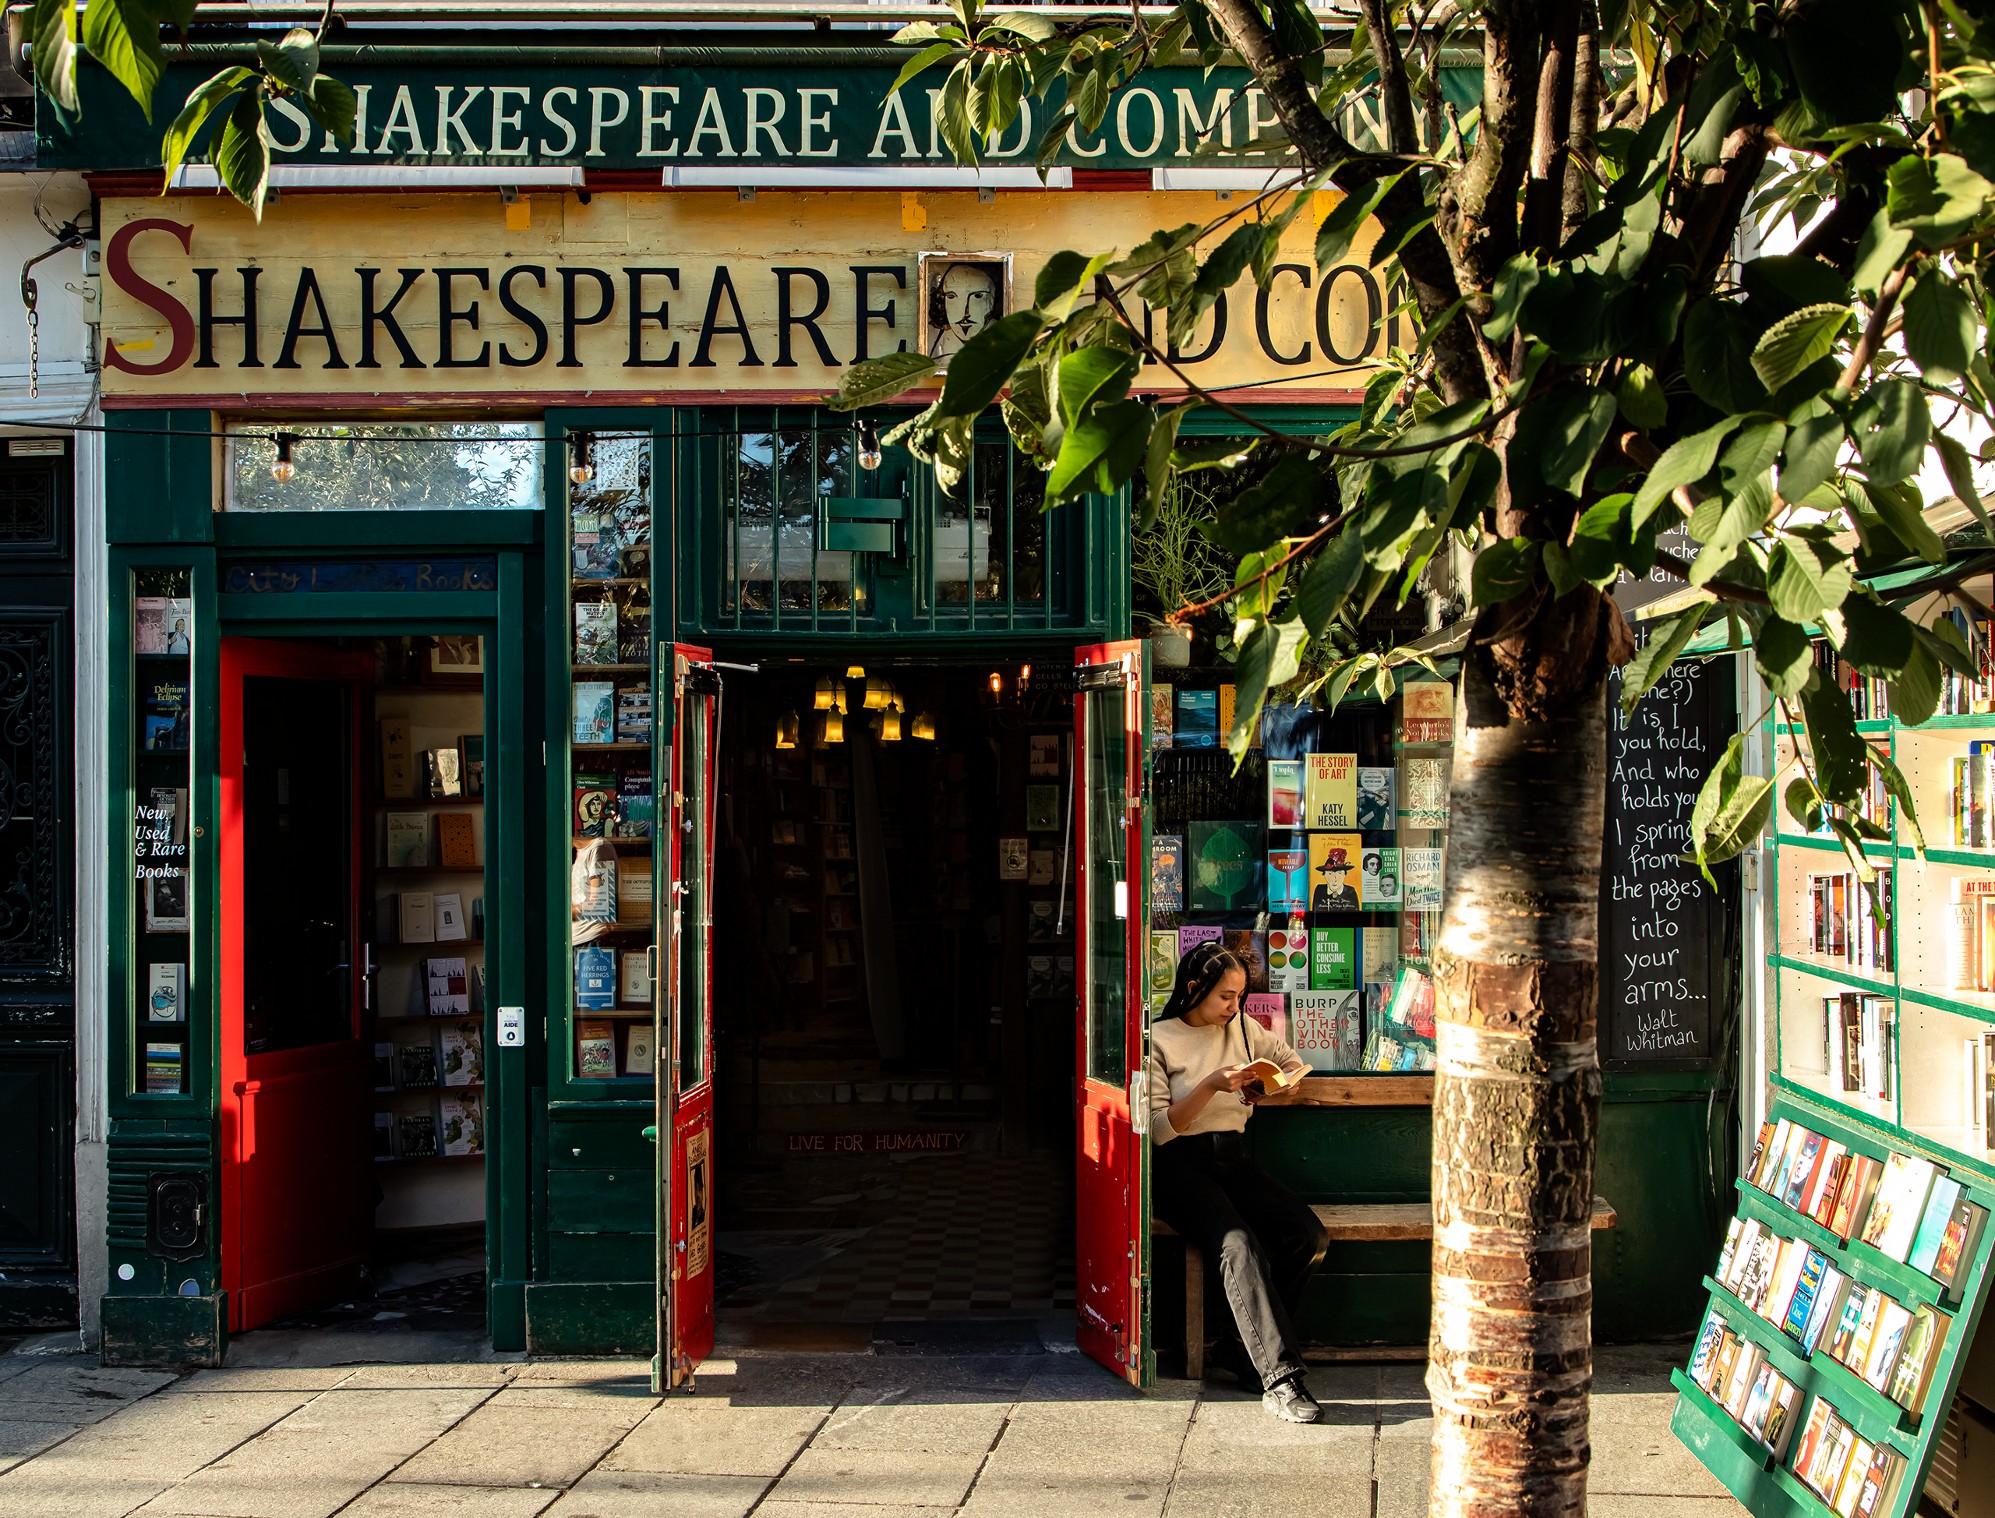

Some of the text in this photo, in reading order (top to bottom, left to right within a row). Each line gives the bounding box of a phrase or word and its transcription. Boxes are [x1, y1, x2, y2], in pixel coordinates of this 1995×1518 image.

[268, 84, 838, 157] SHAKESPEARE
[104, 218, 907, 375] SHAKESPEARE
[1643, 707, 1661, 728] is
[1672, 703, 1679, 729] I
[1615, 726, 1706, 759] you hold,
[1311, 757, 1354, 767] THE STORY
[1319, 769, 1347, 779] OF ART
[1612, 756, 1700, 782] And who
[1622, 784, 1670, 810] holds
[135, 805, 169, 822] New,
[1322, 804, 1343, 814] KATY
[1318, 815, 1348, 826] HESSEL
[135, 826, 170, 840] Used
[1635, 819, 1694, 854] spring
[135, 843, 186, 856] & Rare
[1406, 862, 1440, 871] OSMAN
[1628, 844, 1680, 877] from
[136, 865, 179, 878] Books
[1612, 875, 1701, 911] the pages
[1966, 882, 1992, 892] AT THE
[1631, 912, 1678, 940] into
[1197, 930, 1217, 938] LAST
[1316, 932, 1329, 941] BUY
[1316, 942, 1339, 952] BETTER
[1316, 953, 1345, 963] CONSUME
[1624, 948, 1679, 981] your
[1316, 964, 1331, 974] LESS
[1625, 978, 1707, 1005] arms...
[1295, 999, 1337, 1008] BURP
[1295, 1009, 1325, 1018] THE
[1637, 1008, 1680, 1032] Walt
[1295, 1019, 1350, 1029] OTHER
[1297, 1039, 1340, 1049] BOOK
[1627, 1030, 1698, 1051] Whitman
[789, 1133, 965, 1150] LIVE FOR HUMANITY
